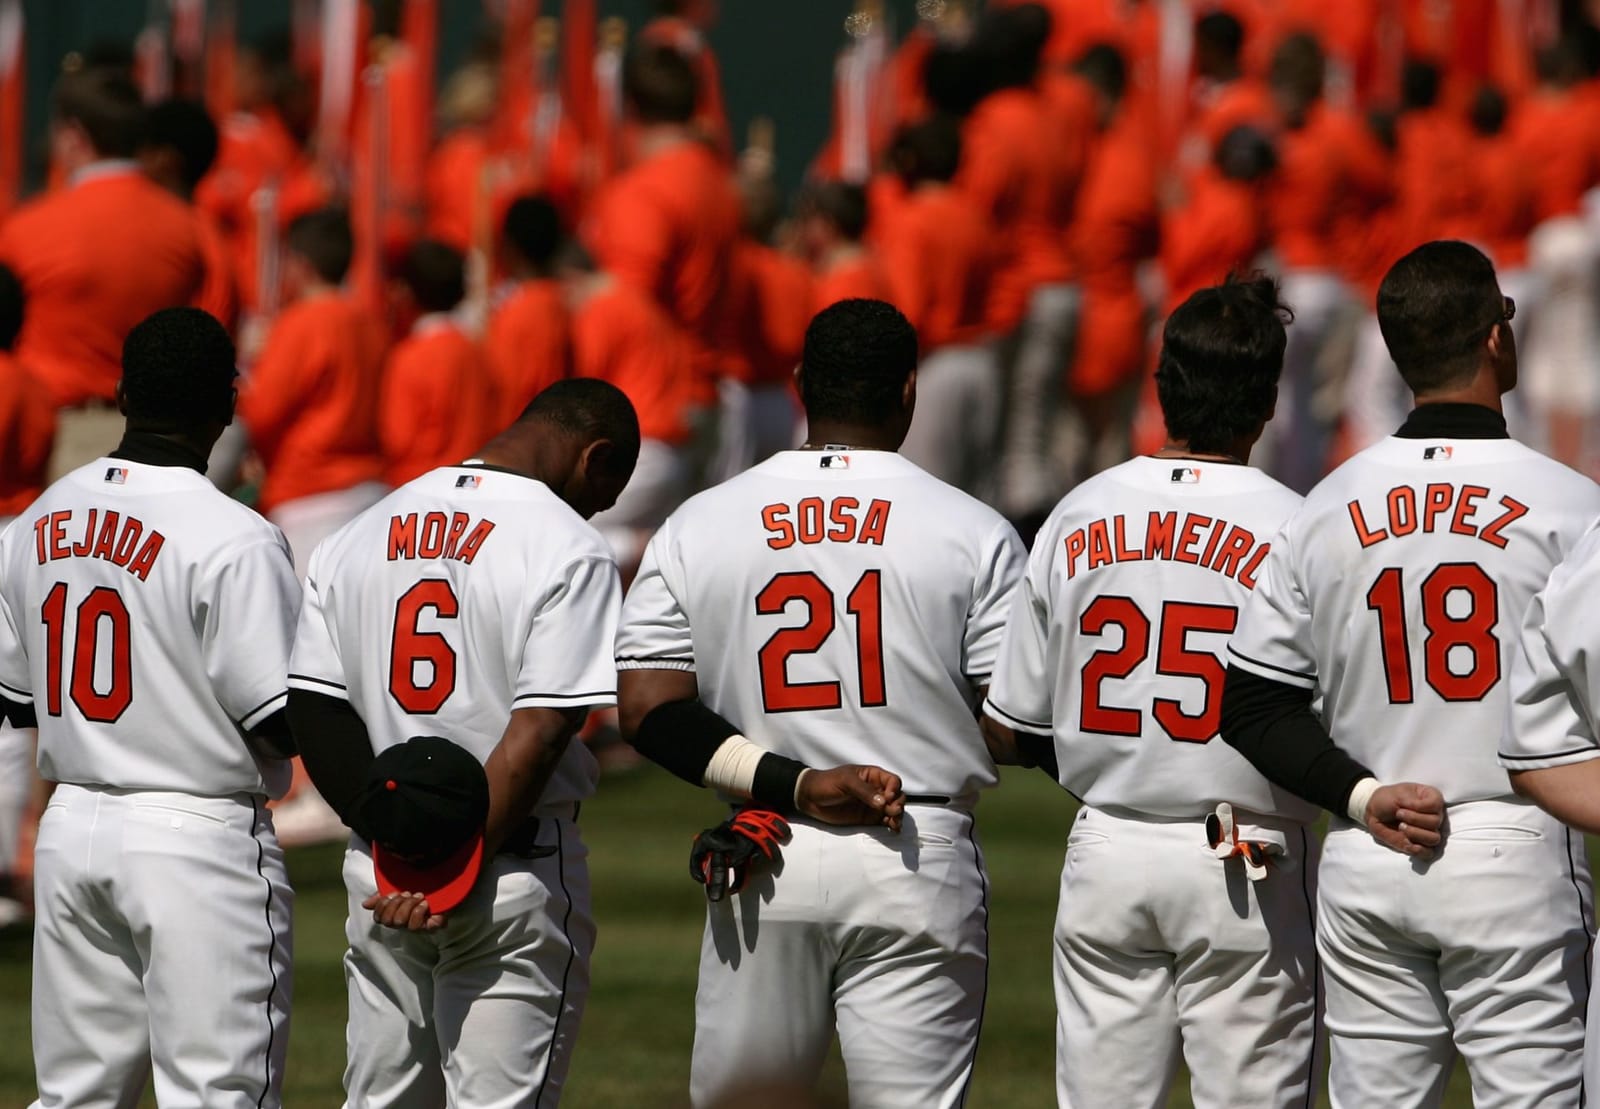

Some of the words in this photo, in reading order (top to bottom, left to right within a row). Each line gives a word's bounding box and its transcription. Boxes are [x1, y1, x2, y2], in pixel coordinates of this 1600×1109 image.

[34, 508, 165, 581] TEJADA
[387, 511, 496, 565] MORA
[761, 496, 892, 550] SOSA
[1348, 482, 1530, 549] LOPEZ
[41, 582, 133, 723] 10
[389, 578, 459, 714] 6
[755, 569, 887, 714] 21
[1079, 595, 1239, 744] 25
[1366, 562, 1502, 705] 18
